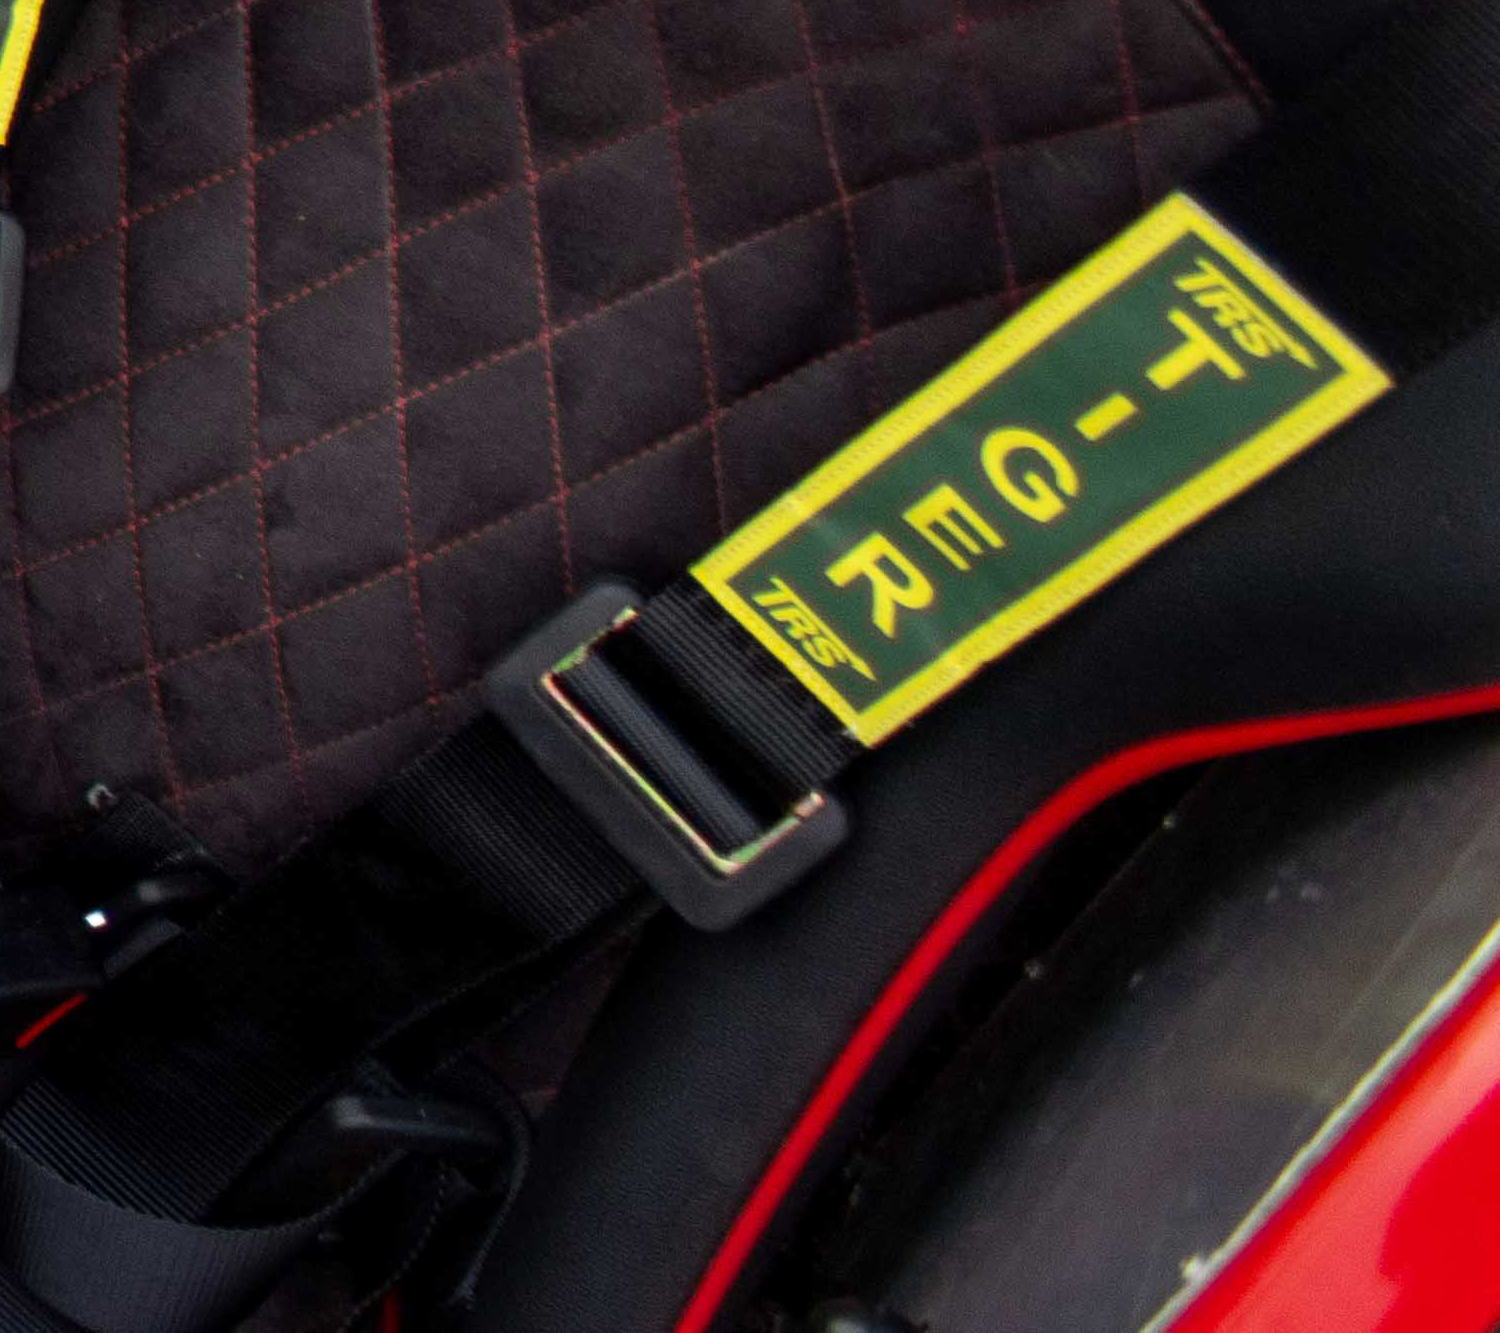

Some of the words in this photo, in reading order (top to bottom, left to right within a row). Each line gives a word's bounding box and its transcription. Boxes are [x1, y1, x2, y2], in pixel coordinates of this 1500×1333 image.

[1173, 256, 1320, 371] TRS
[824, 309, 1248, 641] TIGER
[749, 576, 877, 682] TRS
